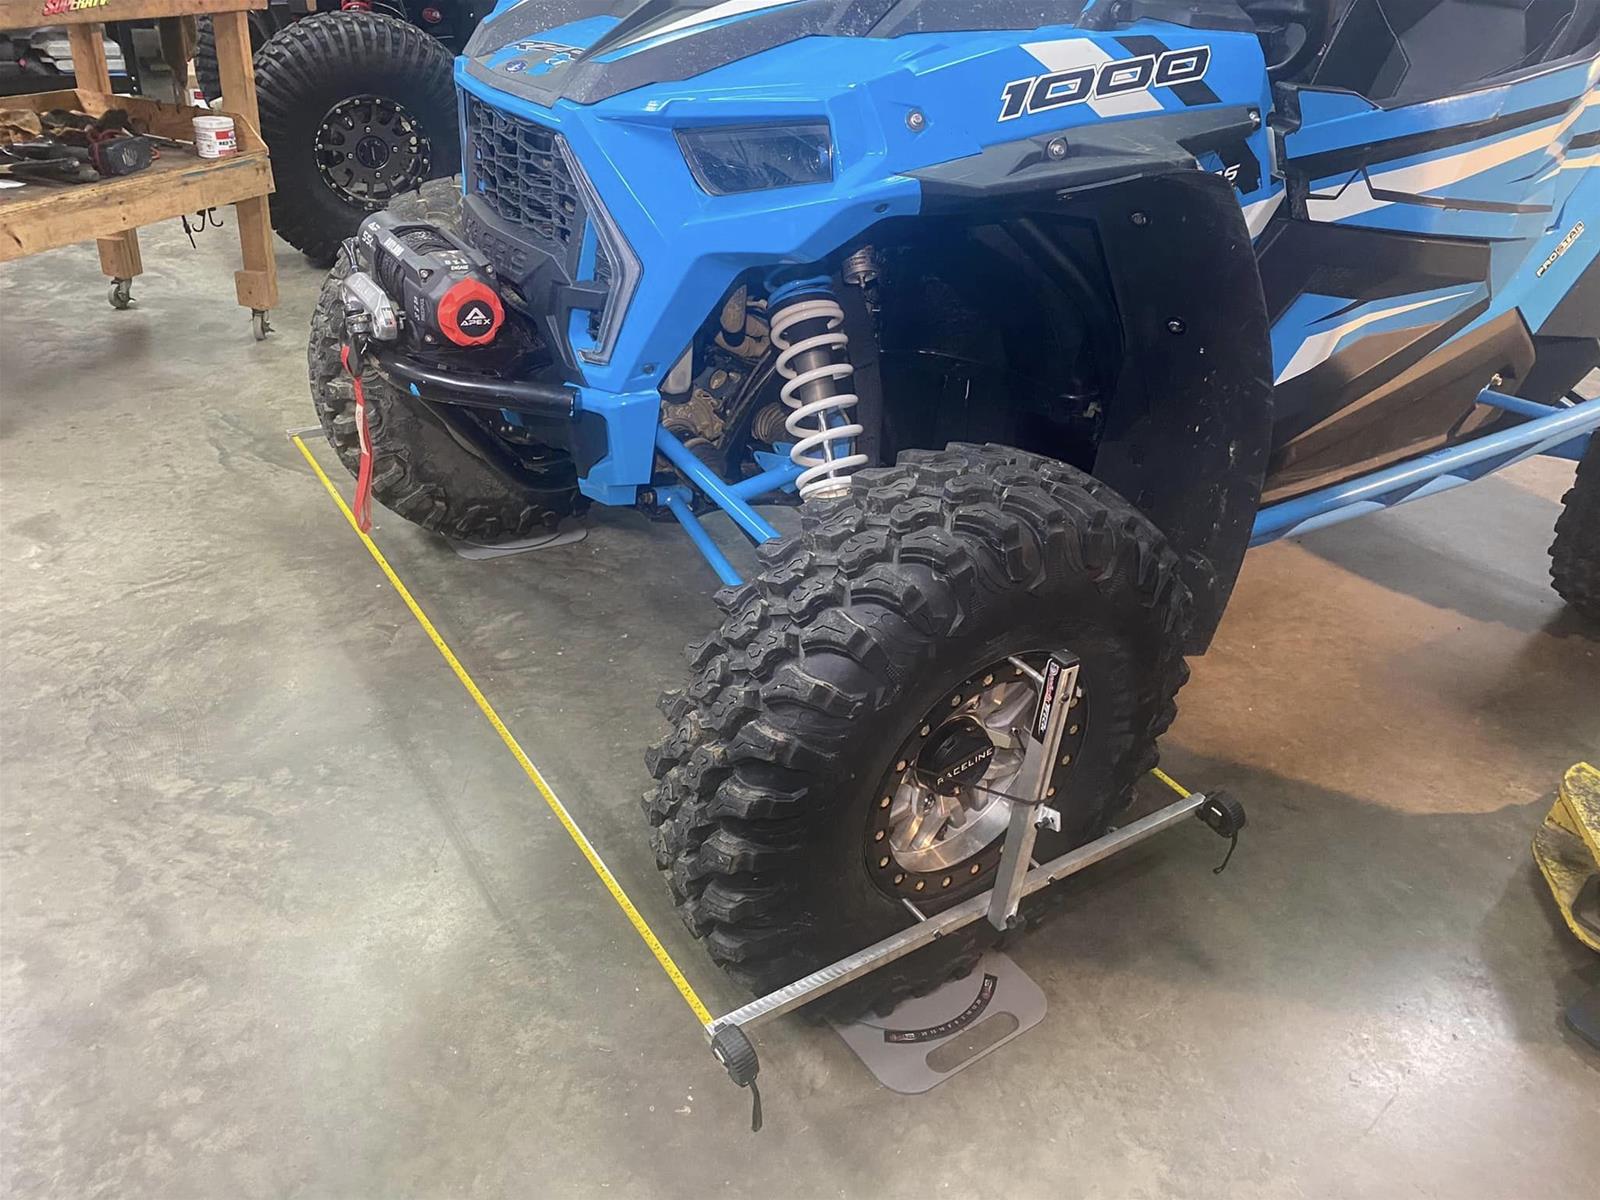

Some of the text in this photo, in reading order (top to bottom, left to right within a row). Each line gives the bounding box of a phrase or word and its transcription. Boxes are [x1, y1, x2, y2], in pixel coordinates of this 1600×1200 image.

[998, 45, 1211, 122] 1000
[1536, 221, 1584, 277] PROSTAR
[460, 316, 492, 327] APEX
[936, 747, 994, 786] RACELINE
